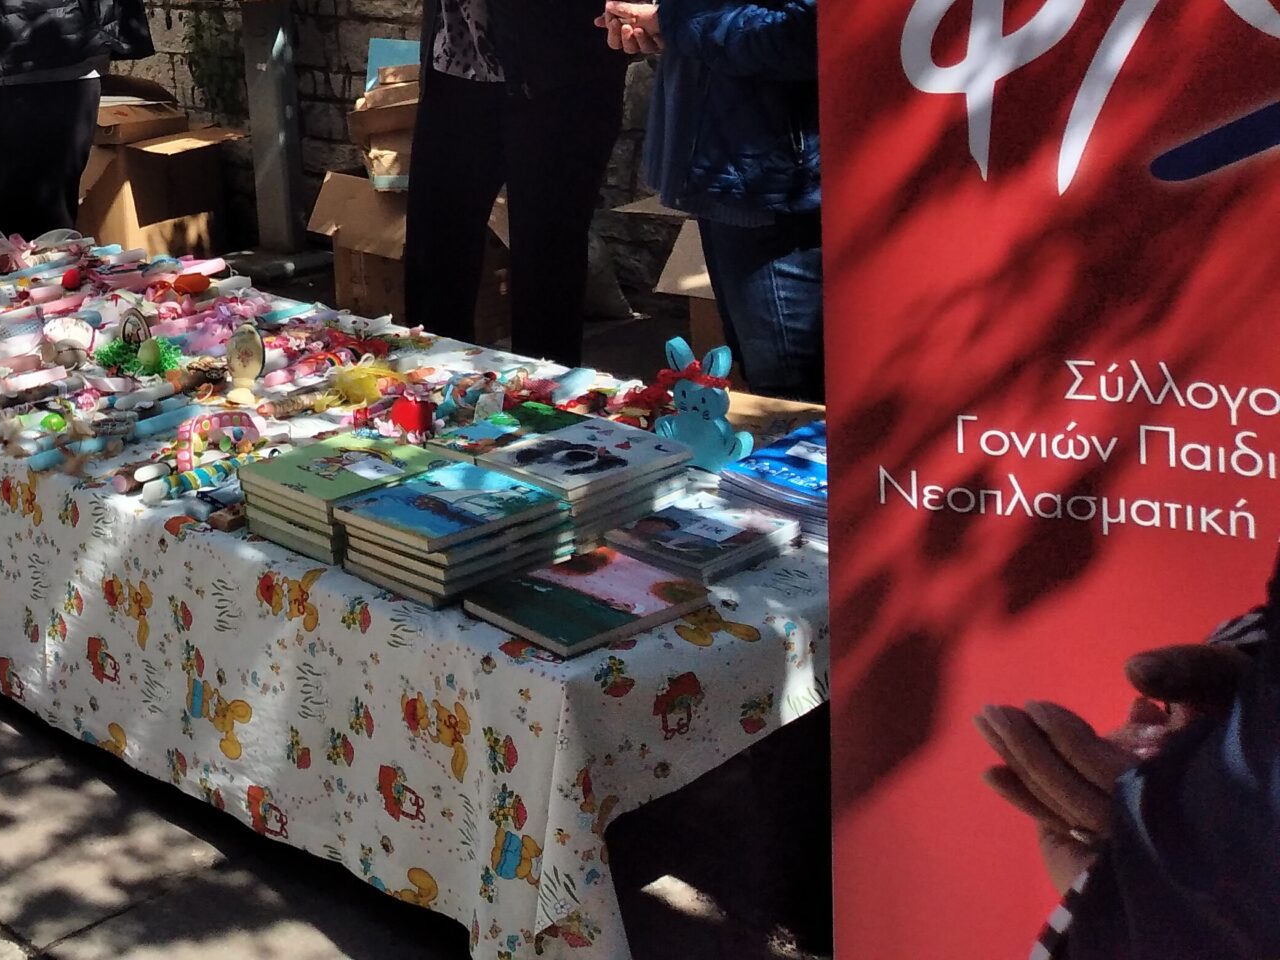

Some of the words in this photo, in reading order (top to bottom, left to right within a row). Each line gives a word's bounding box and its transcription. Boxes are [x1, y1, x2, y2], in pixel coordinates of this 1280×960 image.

[1064, 358, 1280, 426] Σύλλογο
[956, 415, 1119, 462] Γονιών
[1139, 424, 1277, 480] Παιδι
[878, 463, 1257, 540] Νεοπλασματική
